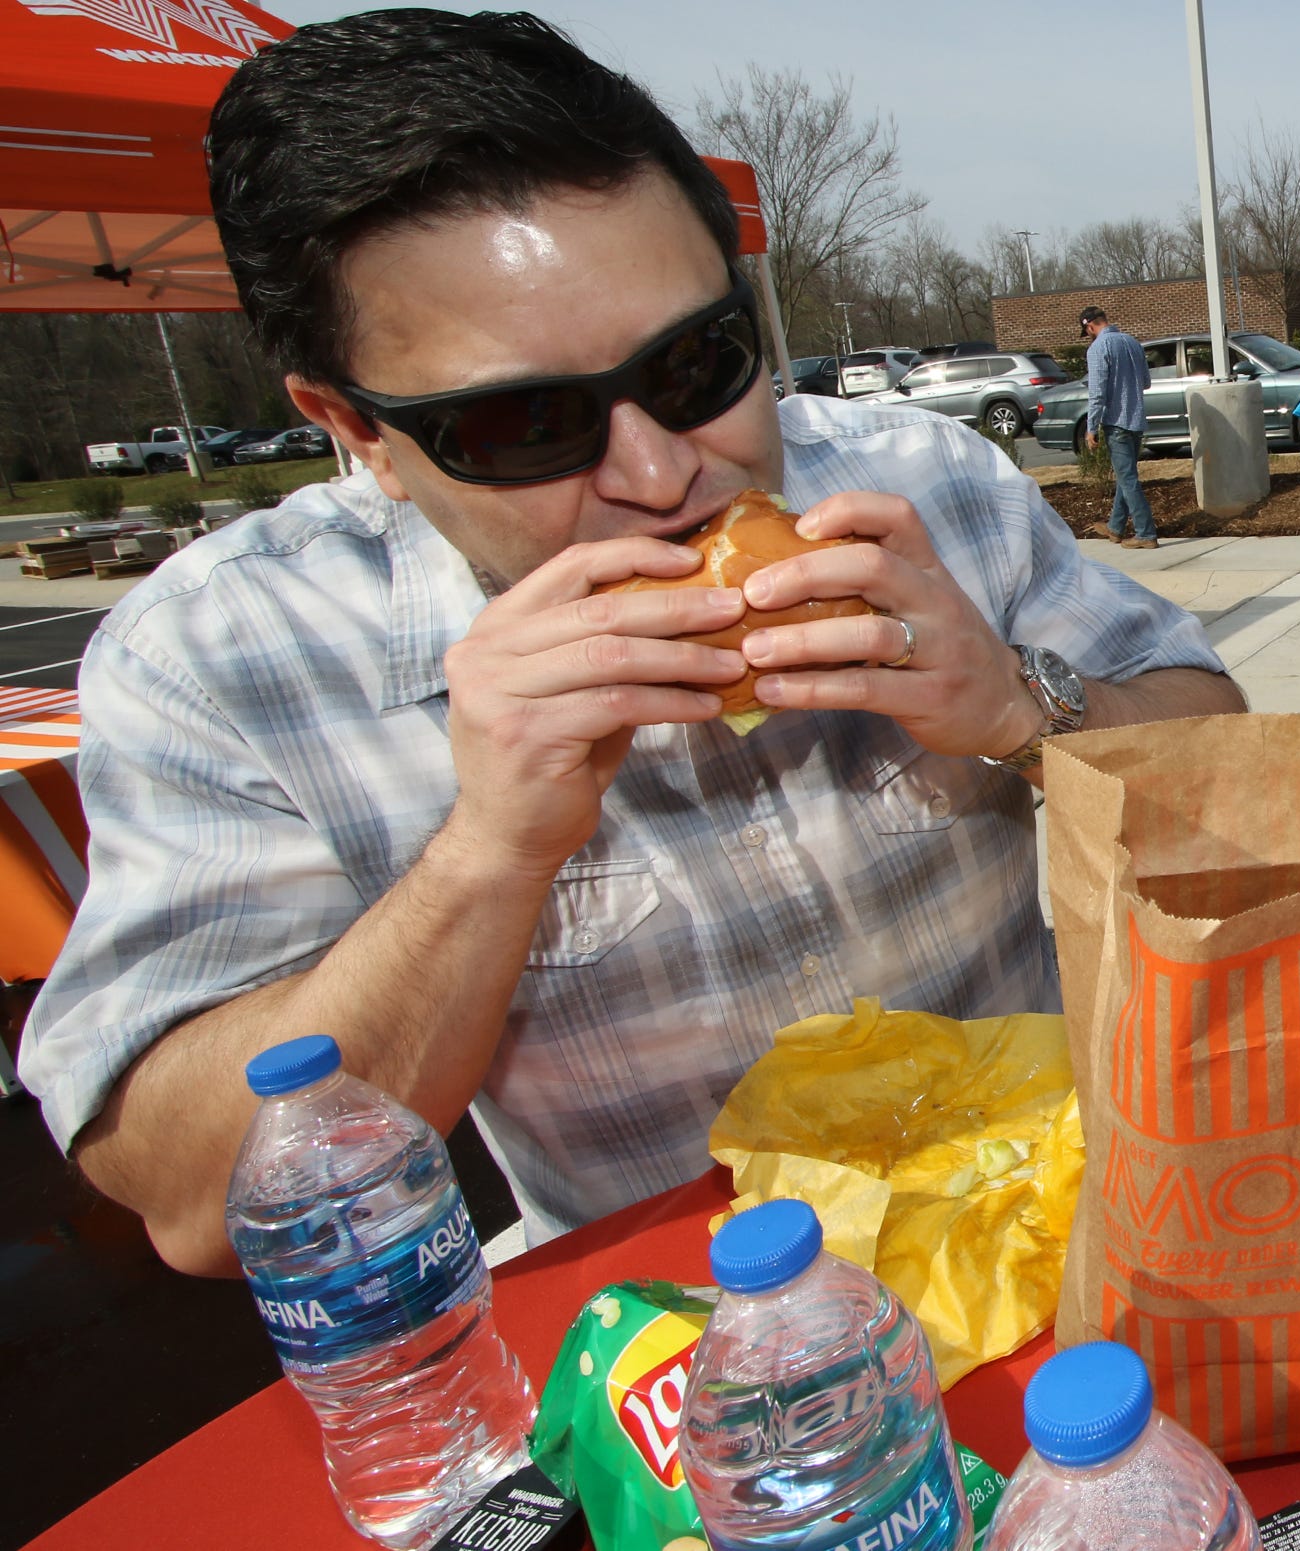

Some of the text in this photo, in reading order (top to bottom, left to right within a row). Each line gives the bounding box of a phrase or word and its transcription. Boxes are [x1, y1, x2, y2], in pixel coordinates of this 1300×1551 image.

[1129, 1140, 1157, 1169] GET
[1138, 1238, 1230, 1279] Every
[1237, 1241, 1299, 1266] ORDER
[355, 1274, 389, 1296] Purified
[364, 1286, 390, 1305] Water
[624, 1350, 697, 1473] La
[508, 1502, 541, 1519] Spicy
[967, 1478, 995, 1511] 28.3
[450, 1510, 552, 1551] KETCHUP
[833, 1481, 940, 1551] FINA
